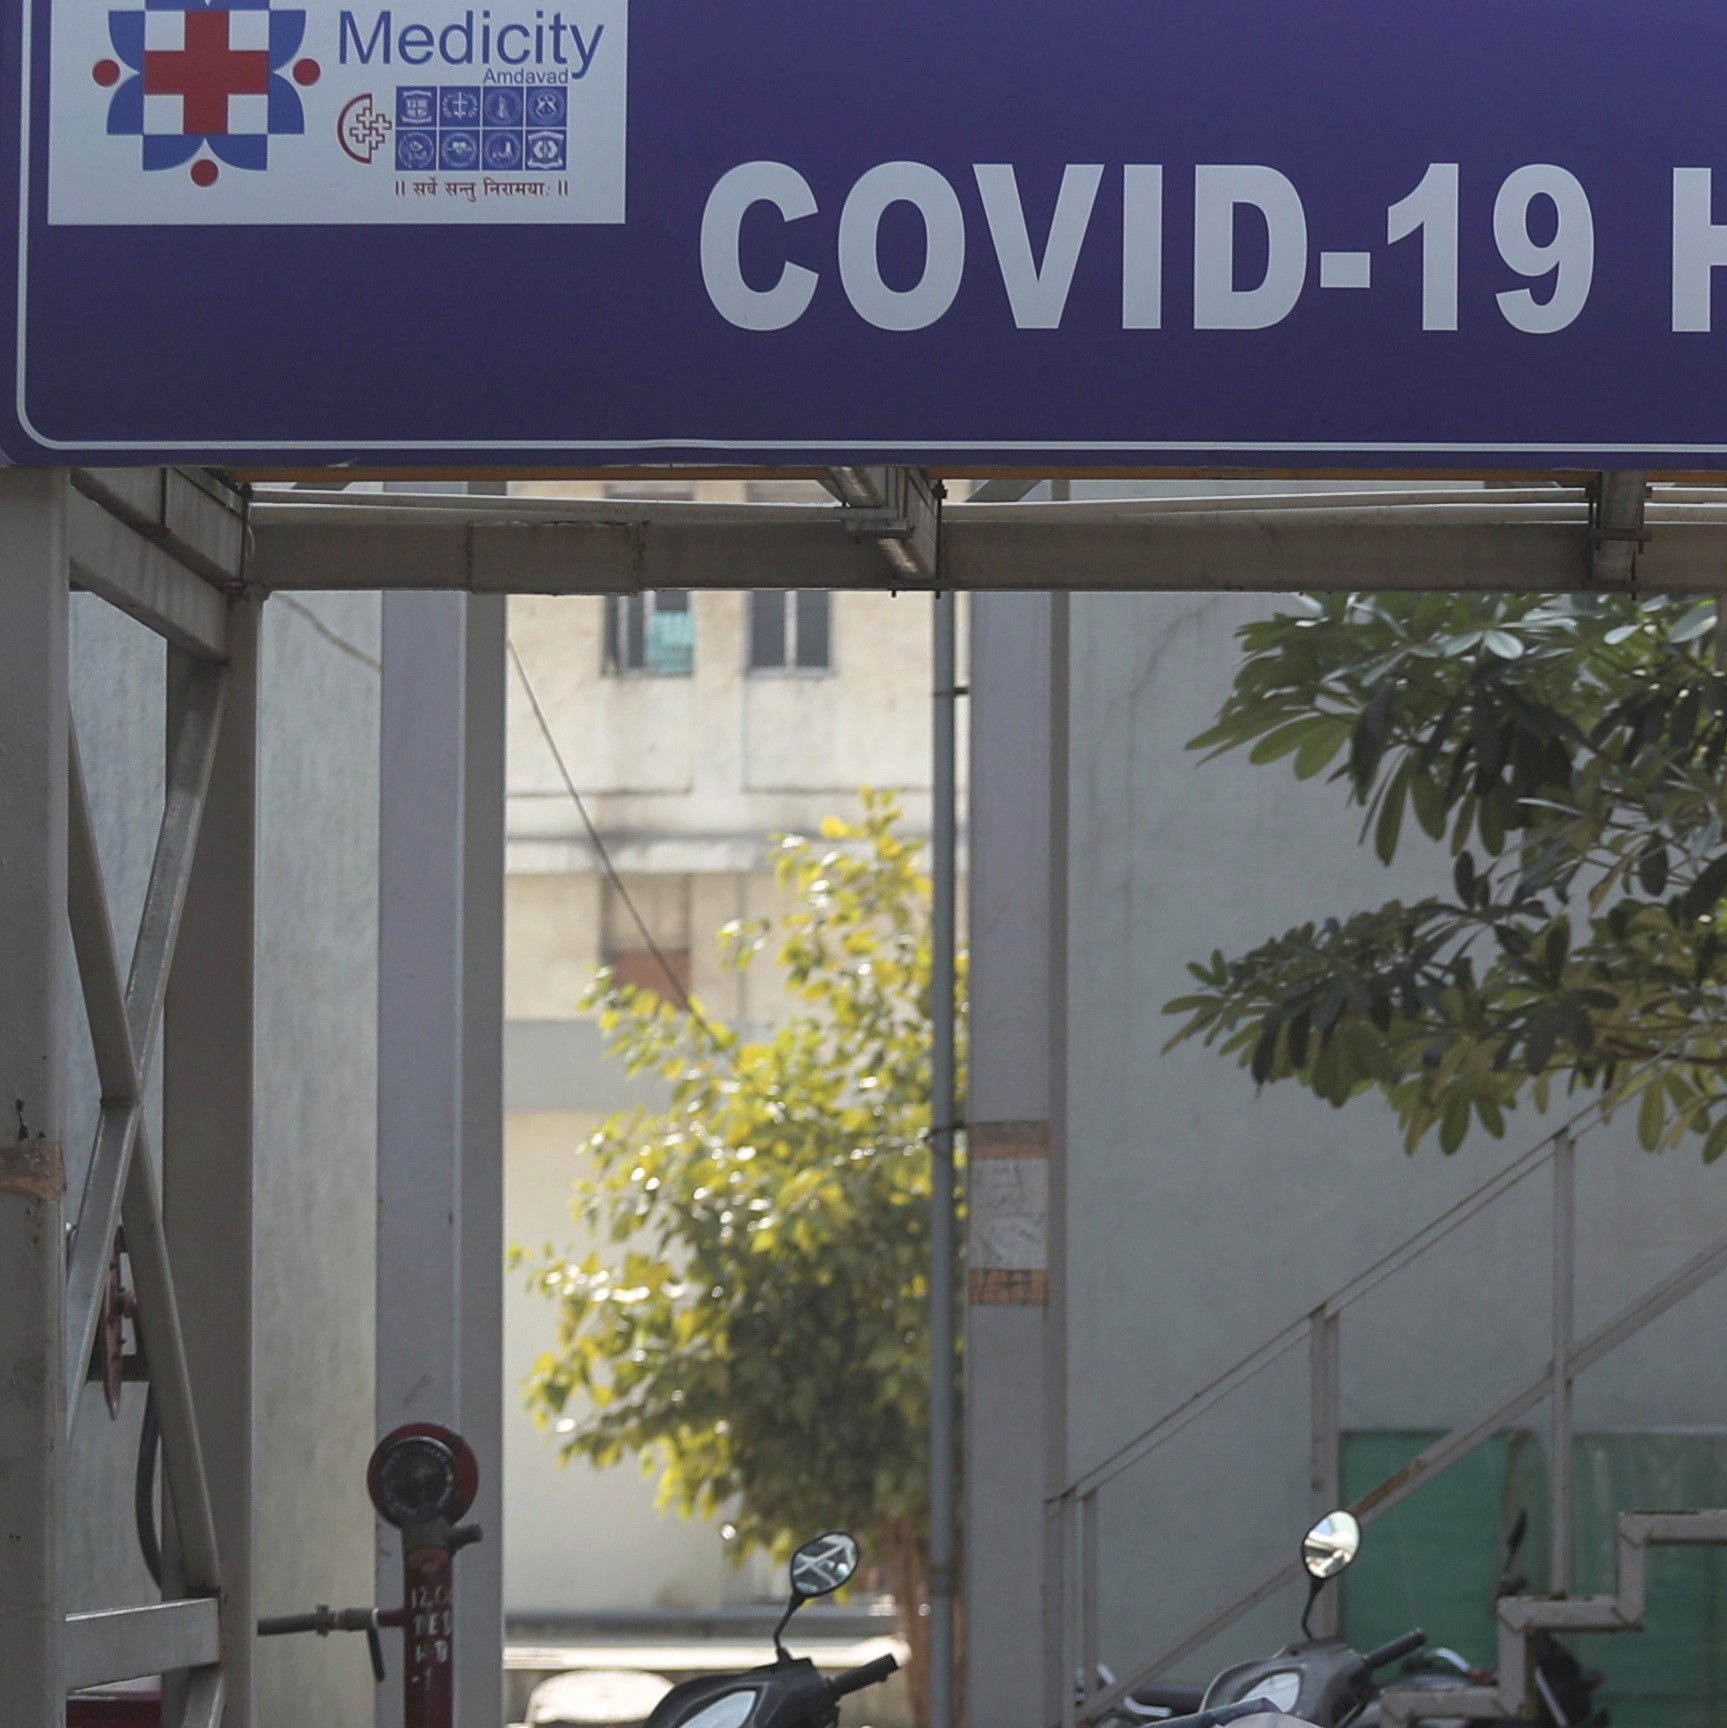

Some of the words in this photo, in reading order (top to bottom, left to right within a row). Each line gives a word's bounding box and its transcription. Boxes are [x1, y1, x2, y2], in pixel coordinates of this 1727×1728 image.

[339, 10, 605, 80] Medicity
[482, 67, 569, 85] Amdavad
[699, 160, 1595, 334] COVID-19
